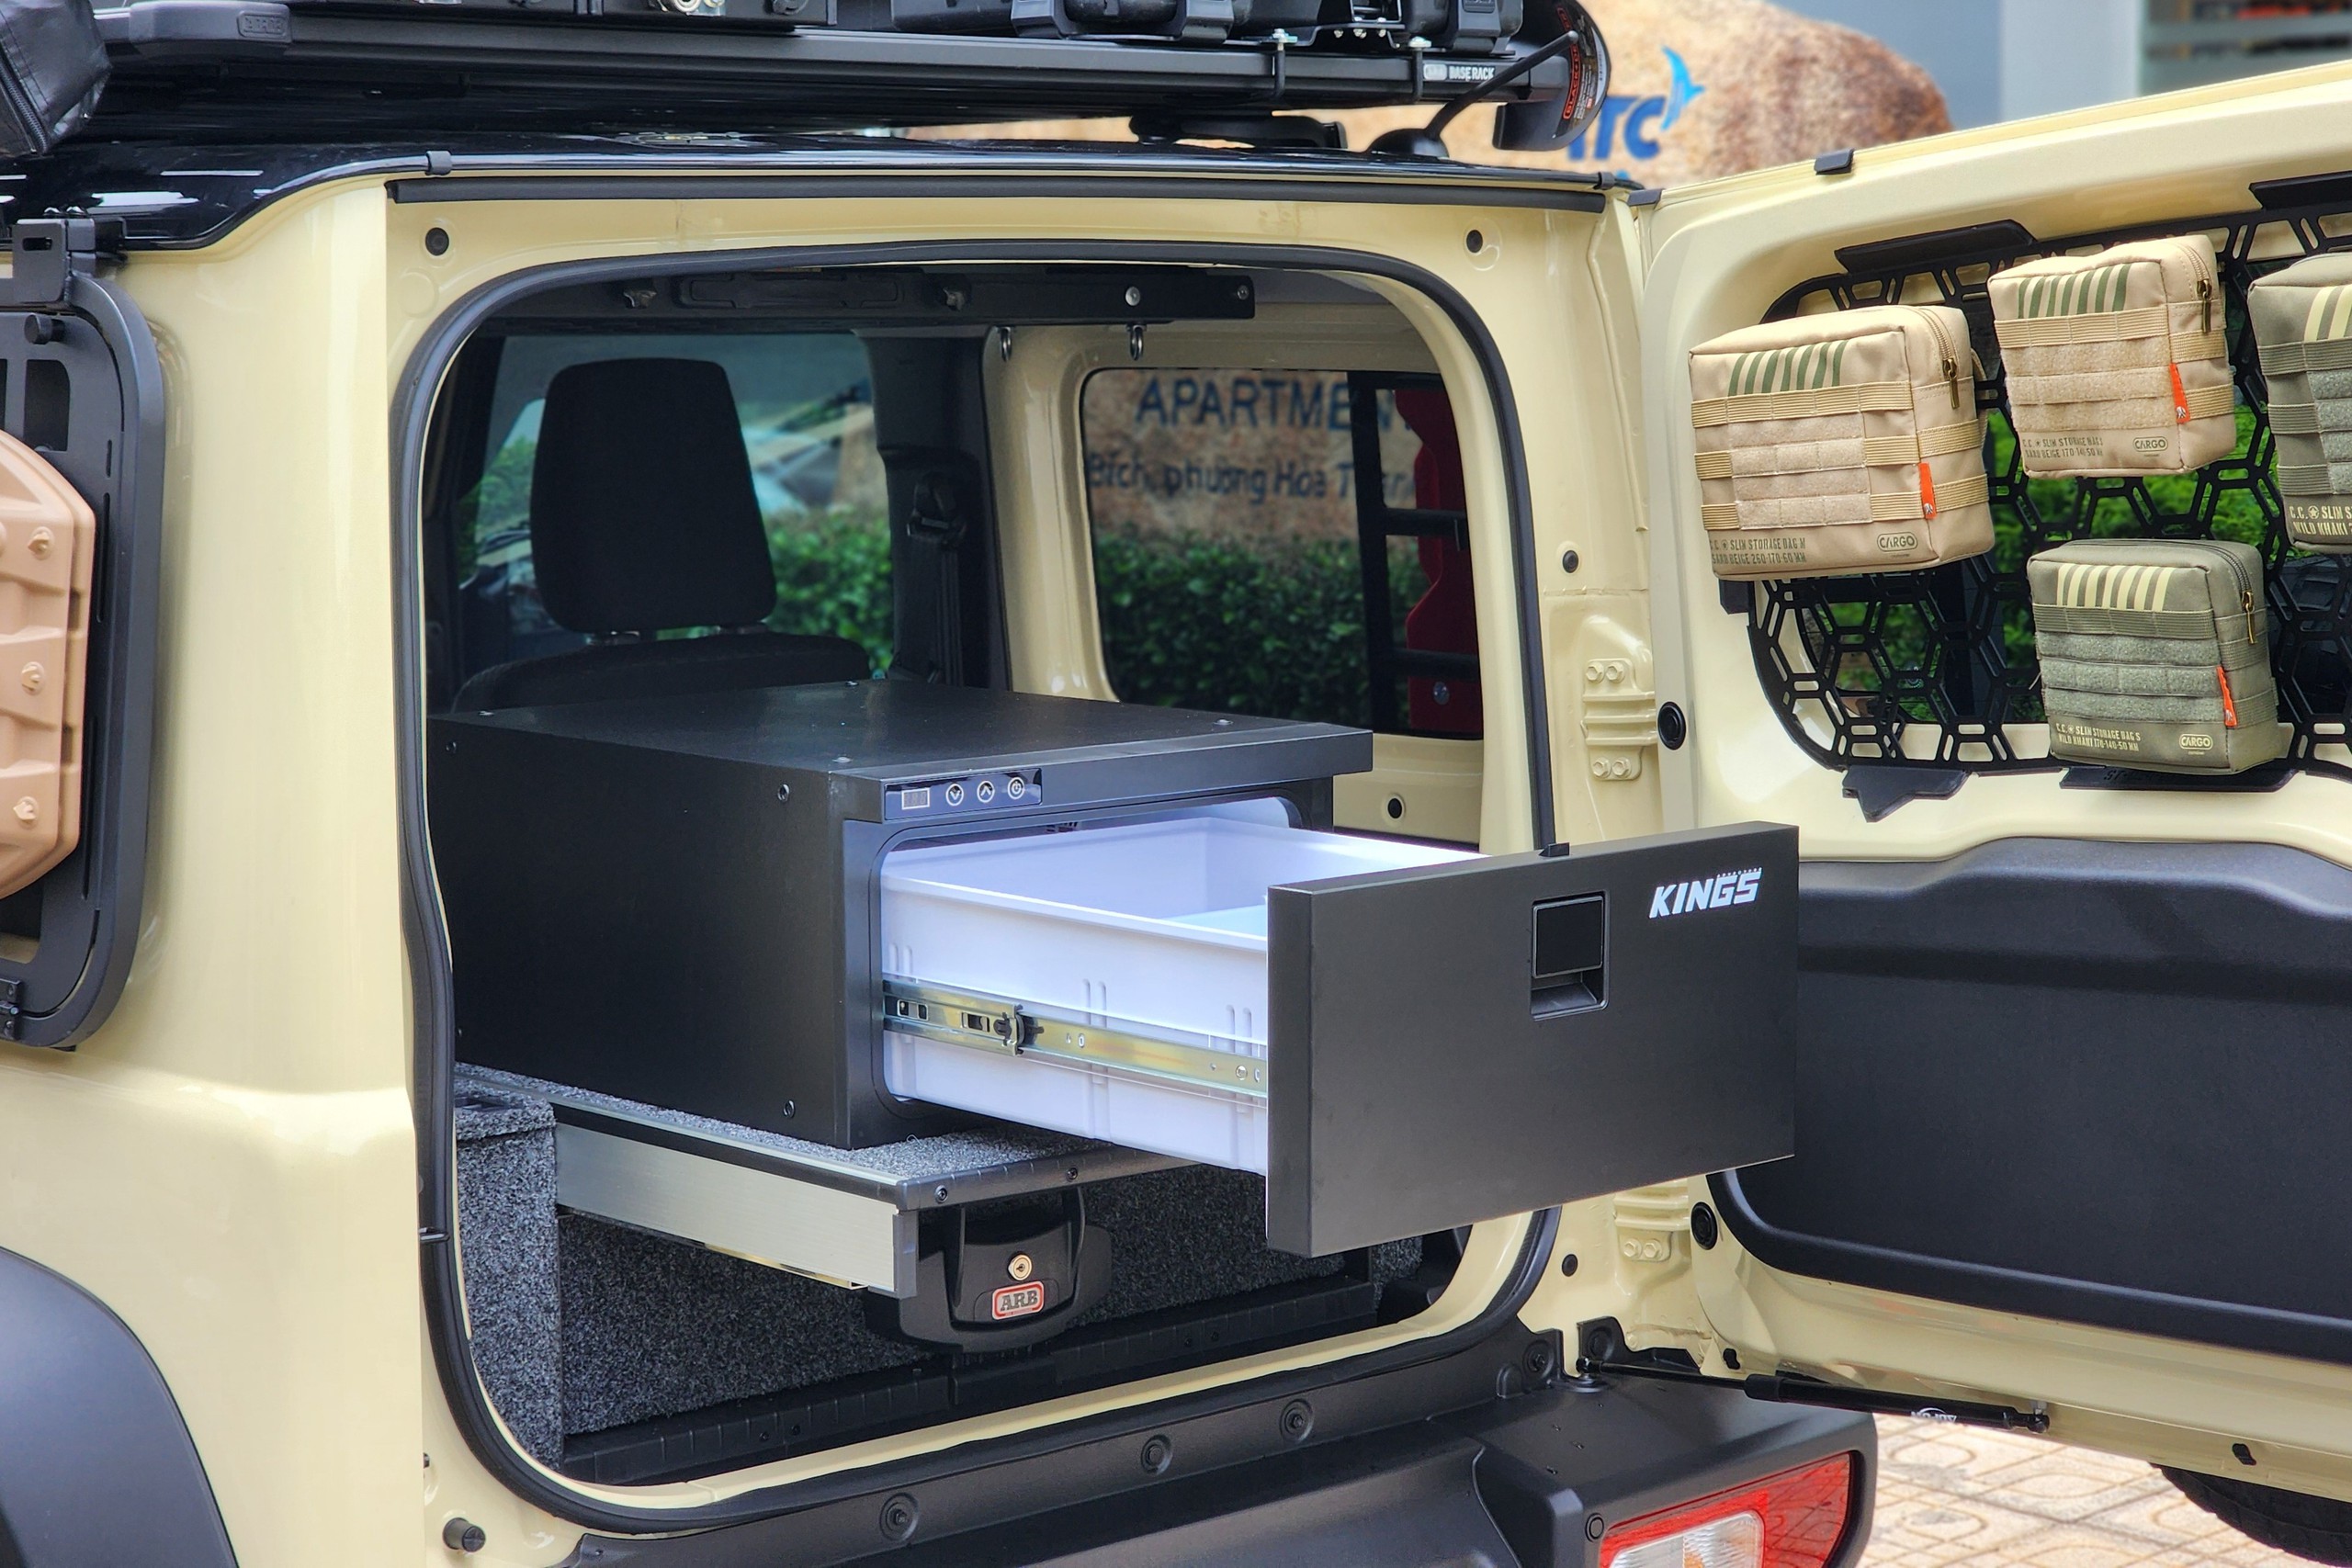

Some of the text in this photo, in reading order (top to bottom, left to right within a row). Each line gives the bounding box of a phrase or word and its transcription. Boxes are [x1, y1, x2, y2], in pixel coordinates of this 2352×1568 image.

[1449, 65, 1471, 82] BASE
[1472, 67, 1496, 81] RACK
[1135, 376, 1411, 432] APARTMEN
[2134, 439, 2166, 449] CARGO
[2289, 505, 2352, 520] C.C. SLIM S
[2293, 522, 2316, 535] WILD
[2317, 522, 2348, 536] KHAKI
[1730, 538, 1746, 550] SLIM
[1748, 537, 1781, 550] STORAGE
[1783, 537, 1798, 549] BAG
[1800, 537, 1806, 549] M
[1879, 536, 1915, 548] CARGO
[1729, 553, 1750, 565] BEIGE
[1751, 552, 1793, 564] 260-170-60
[1794, 551, 1806, 563] MM
[2075, 726, 2092, 736] SLIM
[2092, 728, 2120, 739] STORAGE
[2120, 731, 2135, 741] BAG
[2135, 732, 2142, 741] S
[2059, 734, 2072, 744] WILD
[2073, 736, 2093, 748] KHAKI
[2094, 738, 2128, 750] 170-140-50
[2181, 736, 2211, 747] CARGO
[1649, 867, 1762, 919] KINGS
[1000, 1290, 1038, 1311] ARB
